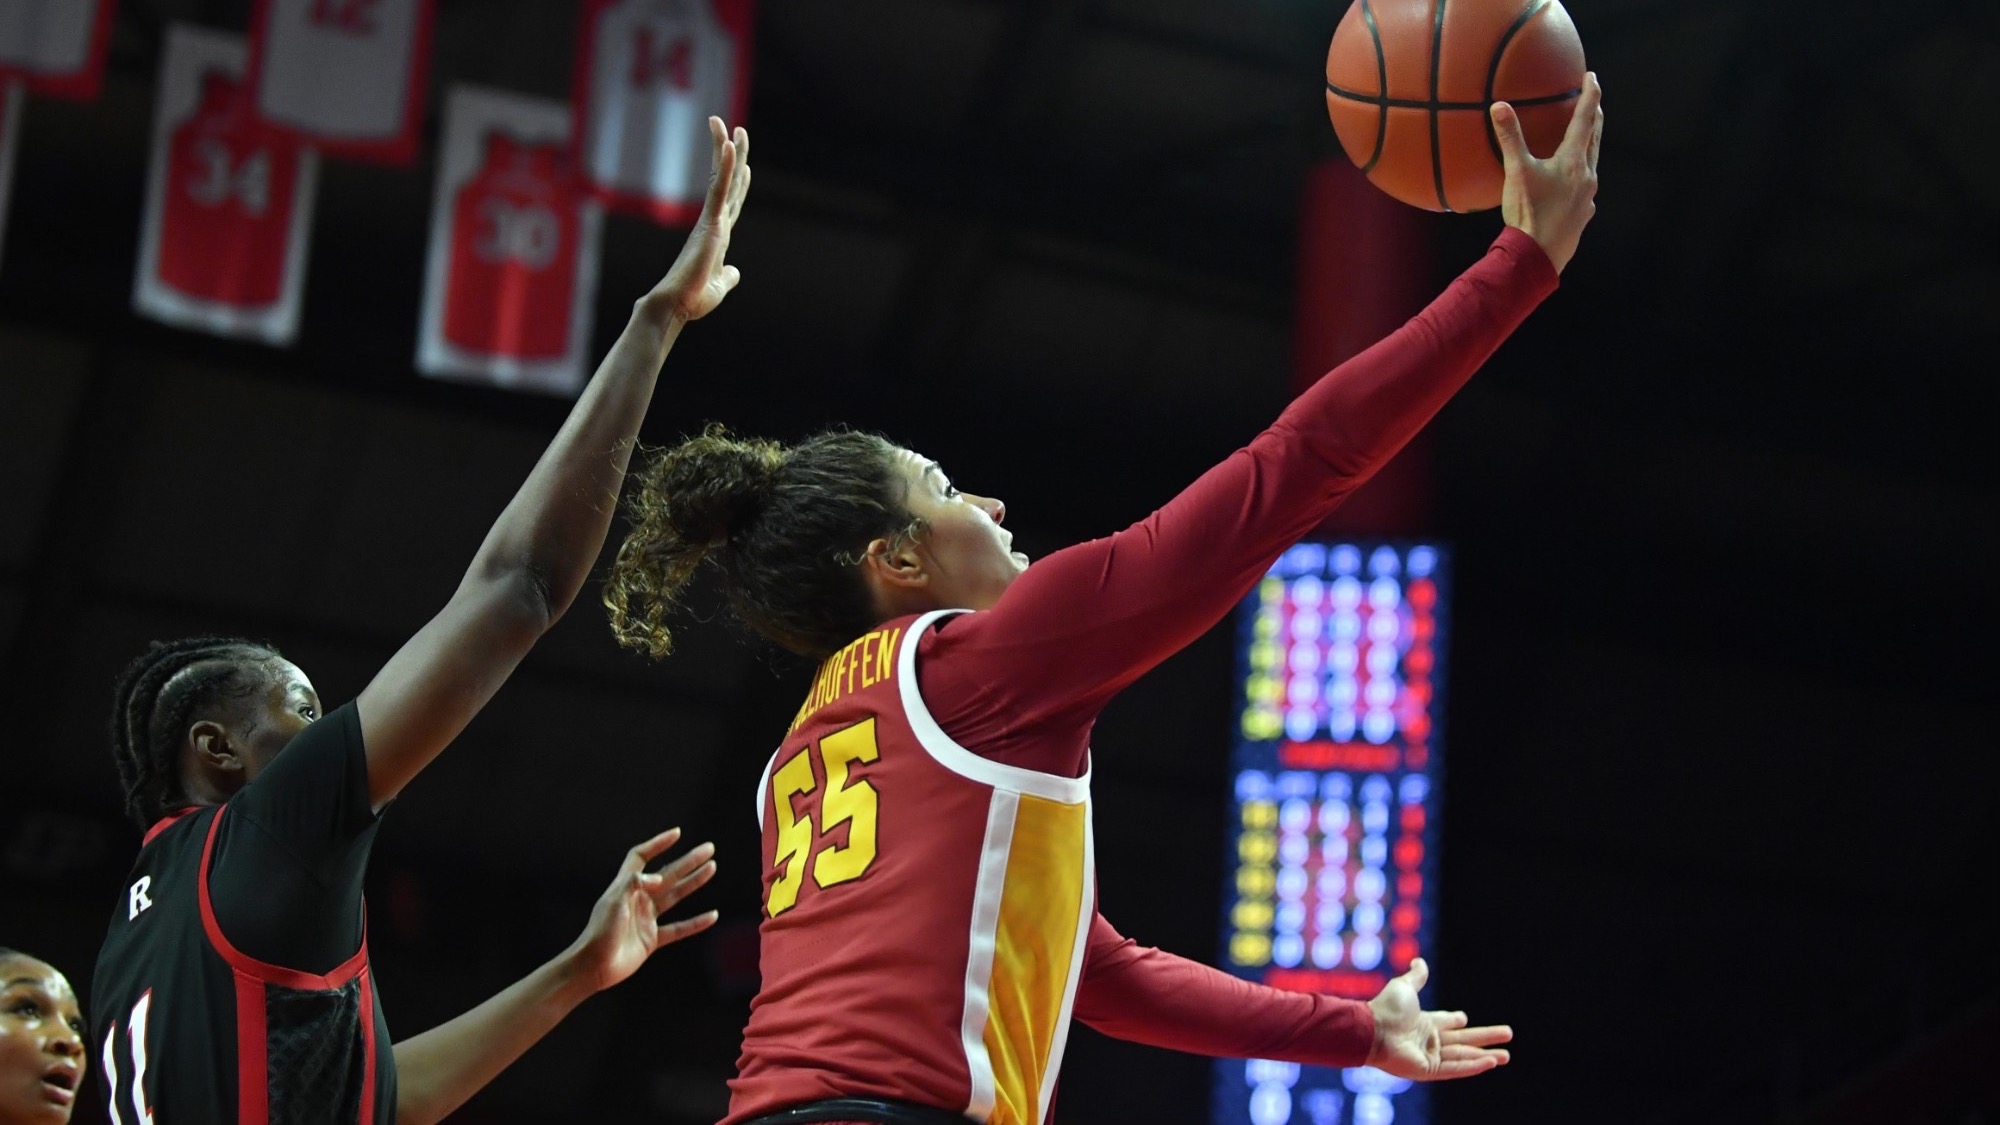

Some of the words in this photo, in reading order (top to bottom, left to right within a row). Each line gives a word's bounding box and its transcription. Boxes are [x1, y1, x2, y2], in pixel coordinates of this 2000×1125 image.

[187, 139, 270, 216] 34
[474, 197, 560, 270] 30
[766, 716, 881, 919] 55
[129, 874, 153, 922] R
